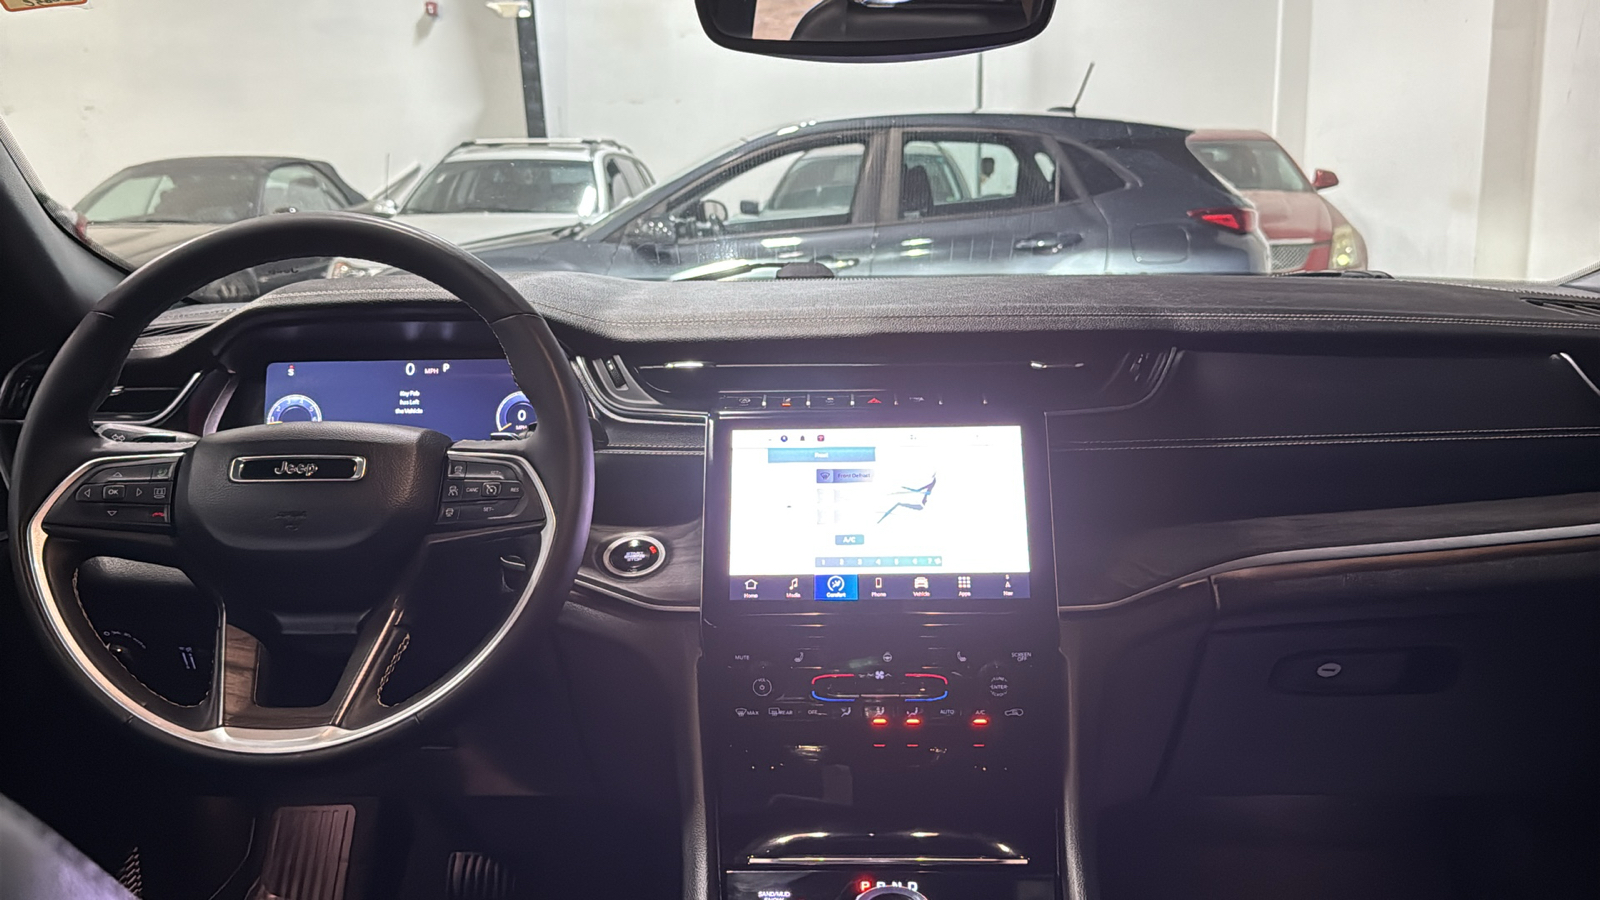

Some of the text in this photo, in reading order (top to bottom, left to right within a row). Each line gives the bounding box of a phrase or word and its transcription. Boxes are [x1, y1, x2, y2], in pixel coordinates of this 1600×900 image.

[405, 362, 450, 376] 0 MPH P
[517, 409, 527, 421] 0
[274, 461, 318, 476] Jeep
[860, 880, 871, 892] P
